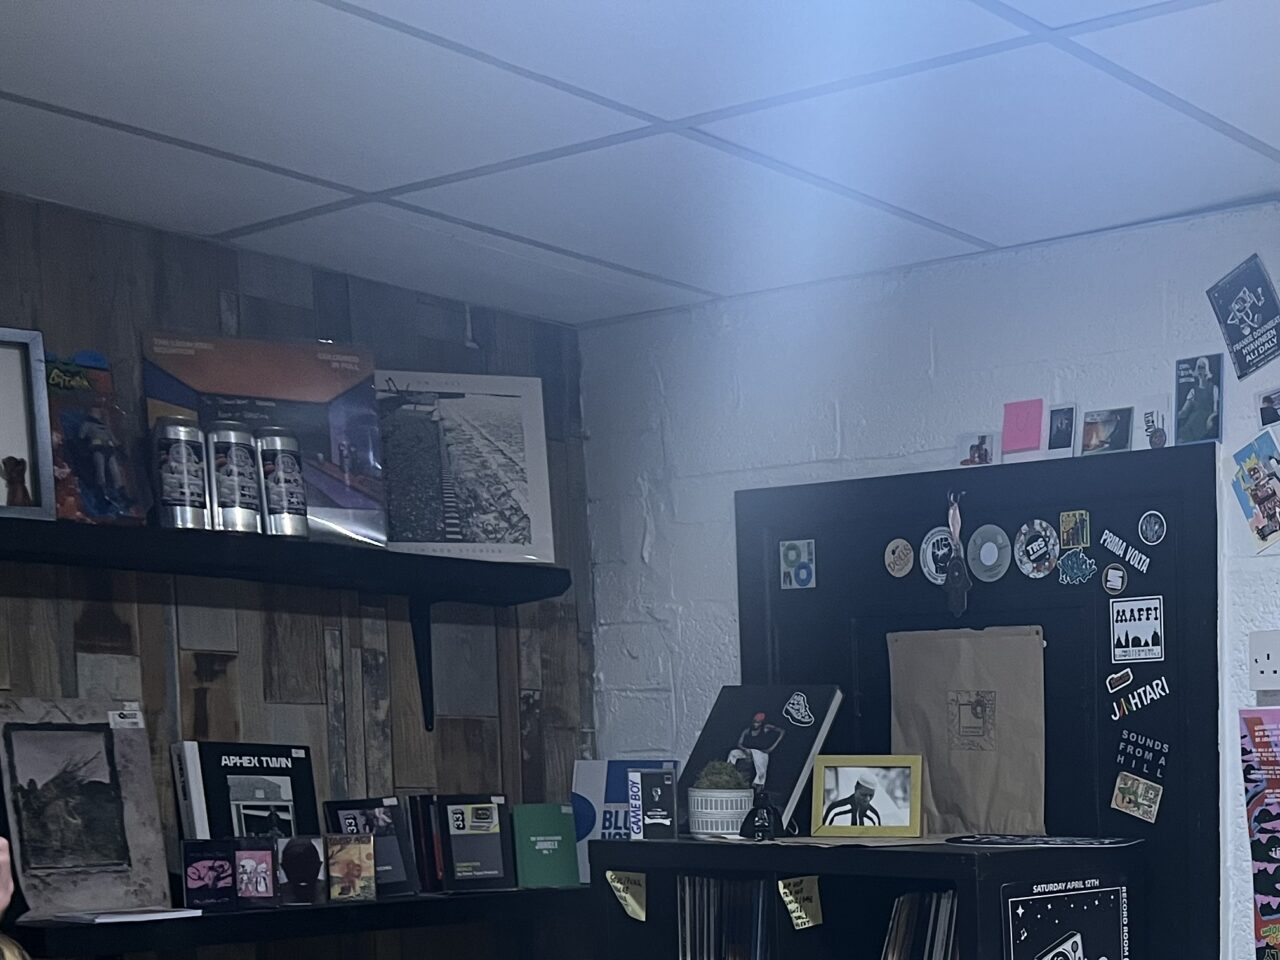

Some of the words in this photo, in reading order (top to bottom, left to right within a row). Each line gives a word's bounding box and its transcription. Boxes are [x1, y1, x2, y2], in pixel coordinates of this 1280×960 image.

[1246, 351, 1258, 363] ALI
[1259, 337, 1278, 354] DALY
[1100, 529, 1125, 559] PRIMA
[1125, 546, 1151, 574] VOLTA
[1115, 607, 1159, 623] MAFFI
[1121, 729, 1169, 753] SOUNDS
[221, 756, 259, 767] APHEX
[262, 757, 292, 768] TWIN
[1119, 742, 1153, 761] FROM
[1158, 756, 1167, 766] A
[630, 780, 641, 802] BOY
[630, 804, 641, 835] GAME
[1033, 881, 1066, 893] SATURDAY
[1066, 880, 1085, 890] APRIL
[1085, 879, 1099, 888] 12TH
